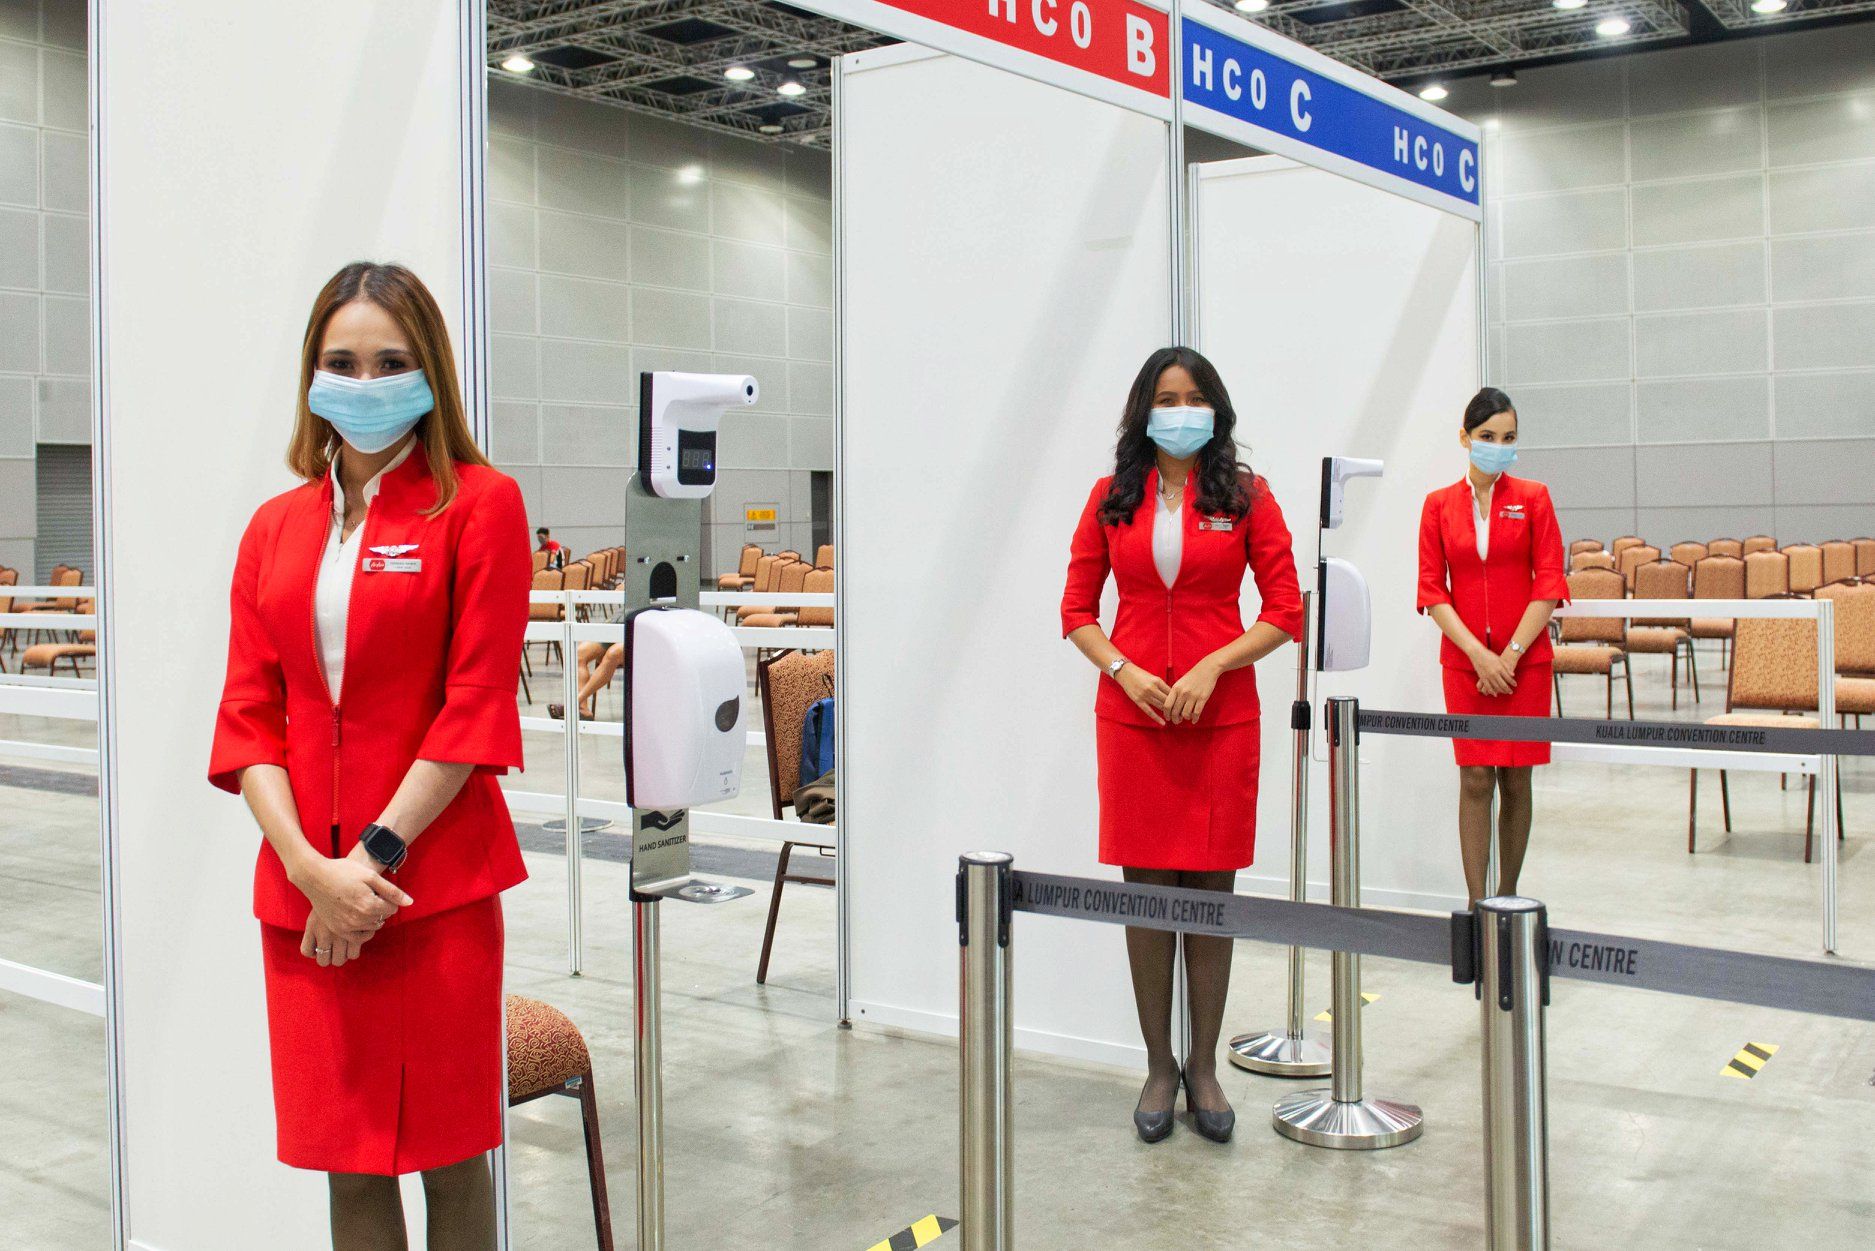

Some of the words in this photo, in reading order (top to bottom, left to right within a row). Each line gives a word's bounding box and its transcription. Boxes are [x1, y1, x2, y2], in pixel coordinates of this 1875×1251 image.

[1126, 13, 1156, 77] B
[1290, 79, 1312, 132] C
[1459, 148, 1475, 193] C
[1359, 714, 1383, 728] MPUR
[1385, 716, 1435, 731] CONVENTION
[1439, 719, 1469, 733] CENTRE
[1596, 725, 1624, 739] KUALA
[1627, 727, 1664, 741] LUMPUR
[1667, 728, 1727, 743] CONVENTION
[1728, 730, 1766, 744] CENTRE
[639, 842, 657, 853] HAND
[657, 835, 686, 848] SANITIZER
[1028, 882, 1080, 909] LUMPUR
[1084, 888, 1167, 921] CONVENTION
[1172, 899, 1225, 926] CENTRE
[1569, 942, 1638, 975] CENTRE
